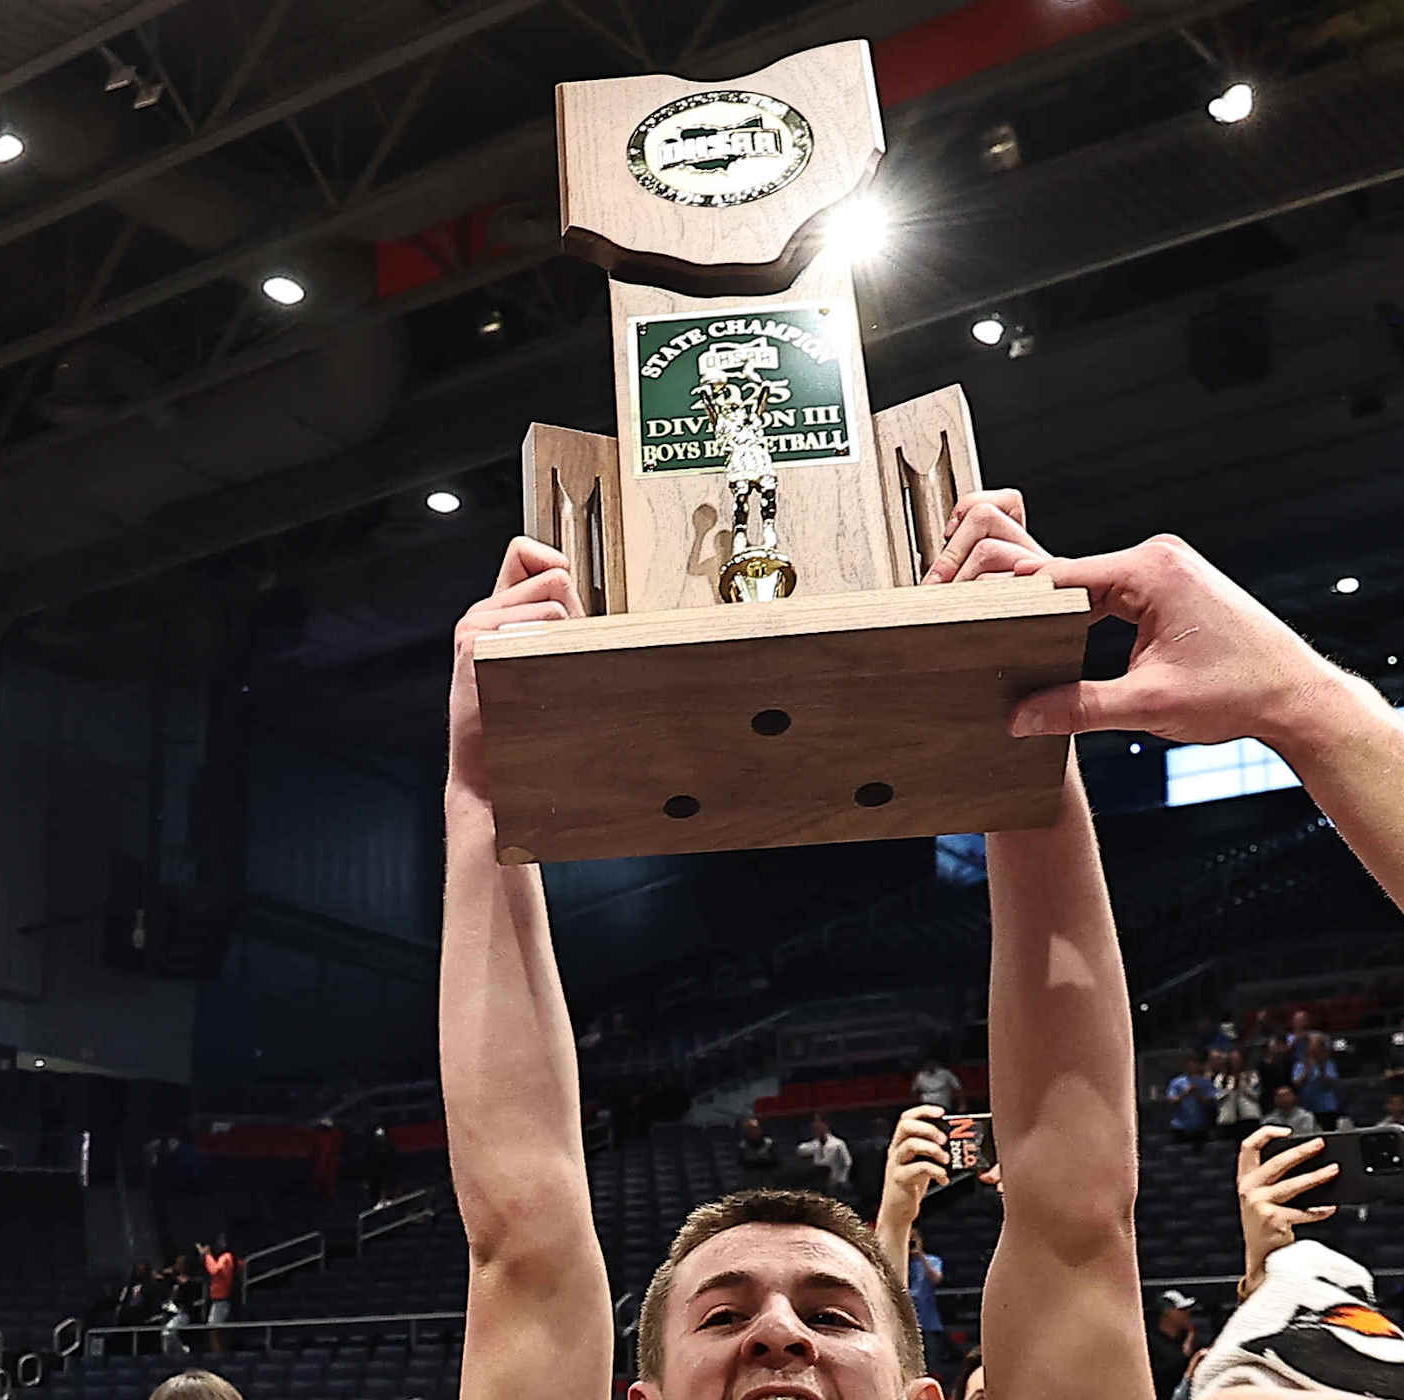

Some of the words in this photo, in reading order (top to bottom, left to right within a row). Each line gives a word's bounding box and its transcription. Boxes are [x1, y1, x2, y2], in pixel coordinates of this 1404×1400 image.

[641, 327, 707, 379] STATE
[802, 405, 842, 426] III
[641, 440, 701, 463] BOYS
